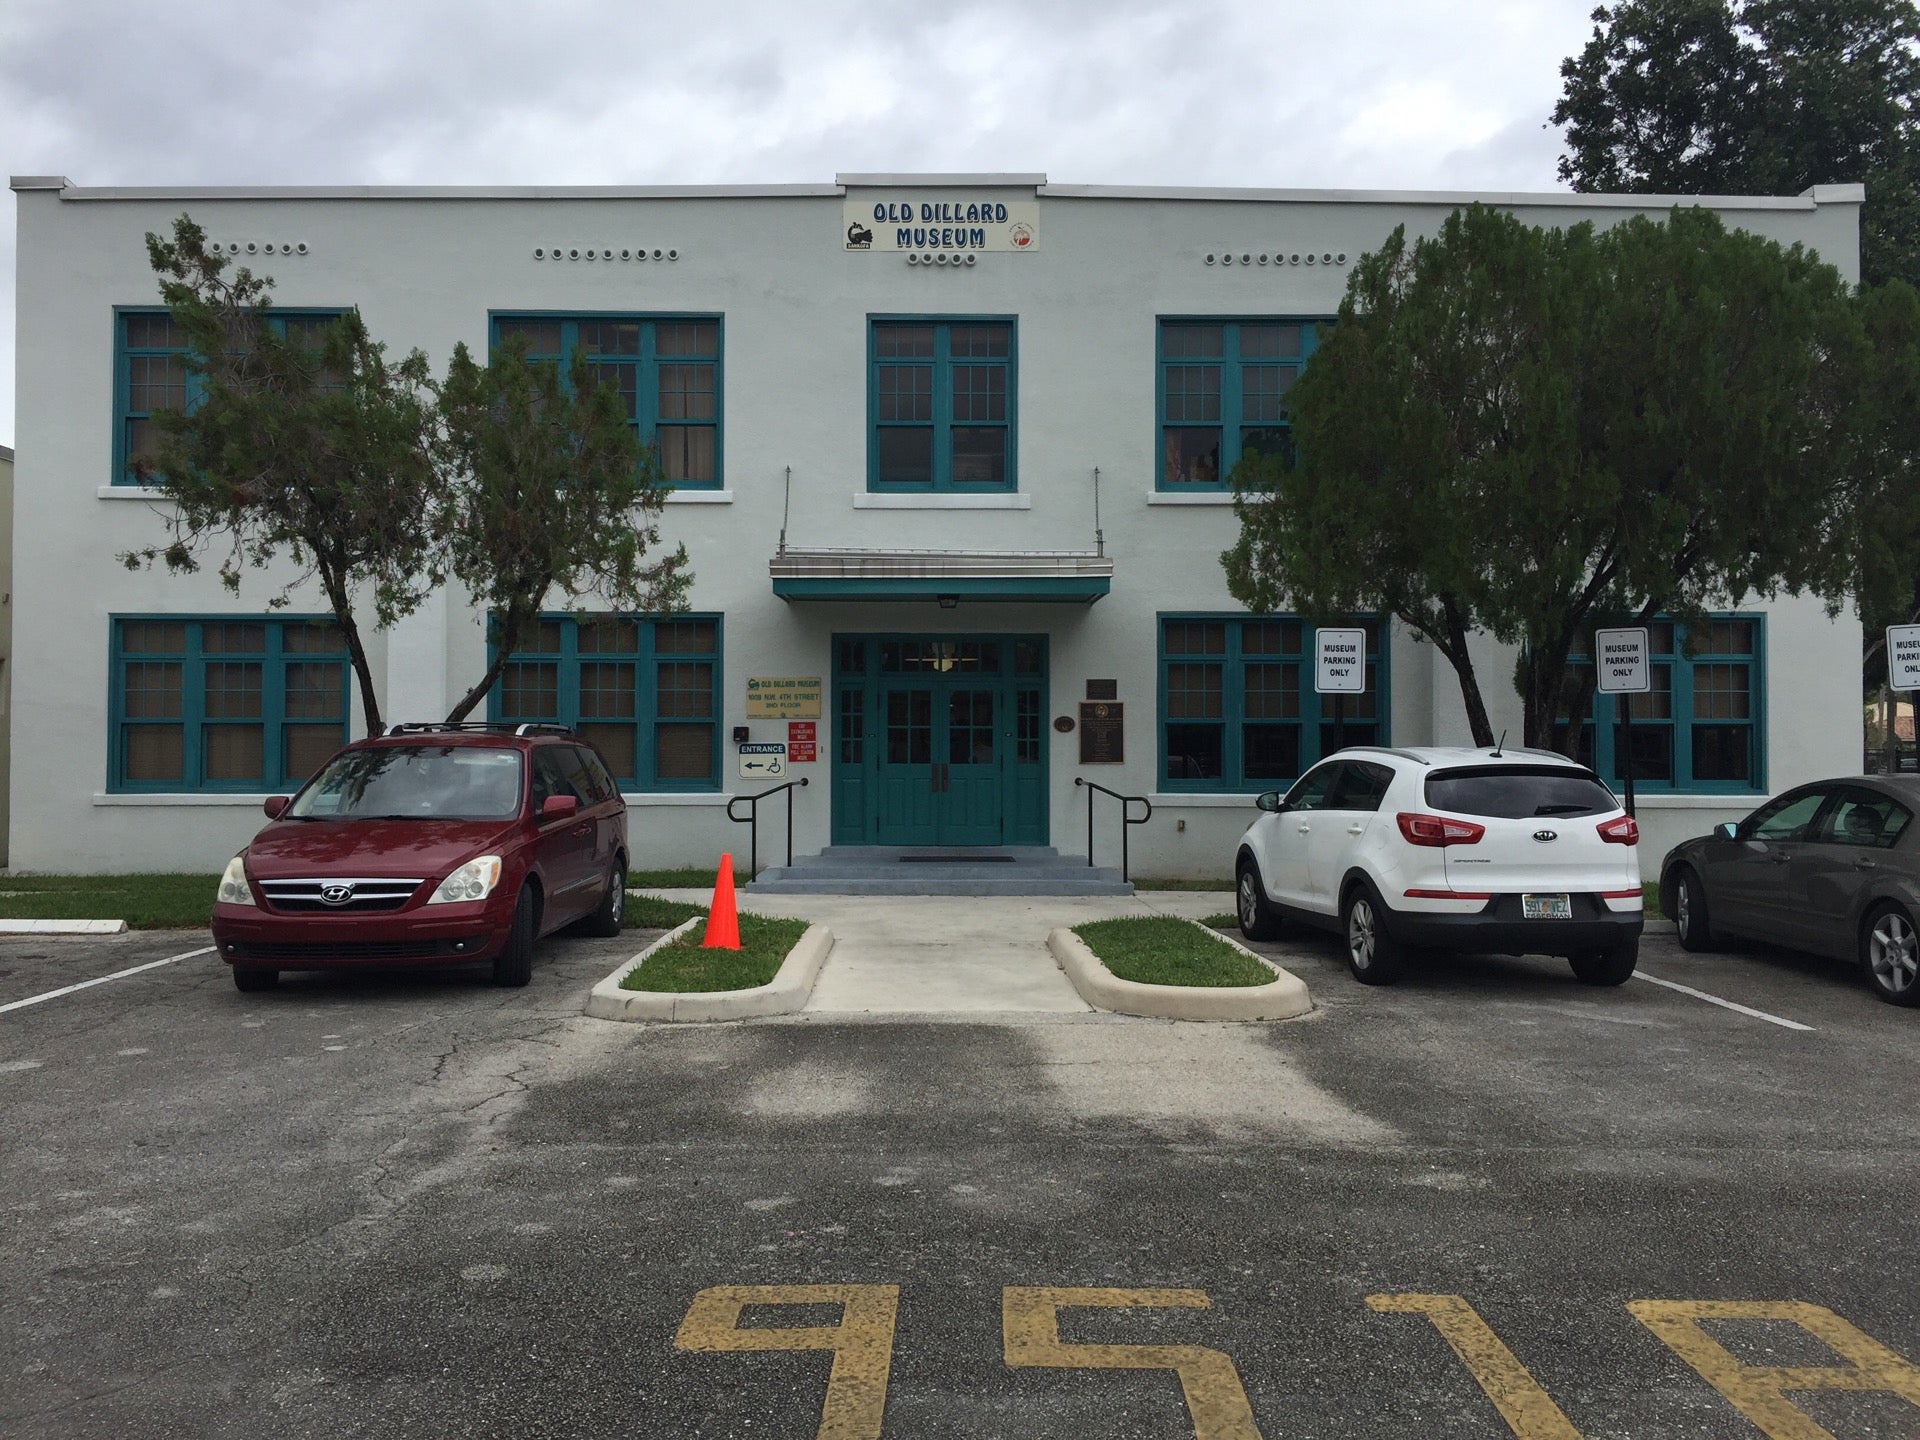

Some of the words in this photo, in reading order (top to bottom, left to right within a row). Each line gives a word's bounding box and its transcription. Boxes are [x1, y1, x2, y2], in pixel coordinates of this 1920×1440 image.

[873, 203, 913, 222] OLD
[921, 203, 1008, 223] DILLARD
[897, 228, 986, 248] MUSEUM
[1605, 644, 1639, 653] MUSEUM
[1605, 656, 1640, 664] PARKING
[1904, 665, 1920, 673] ONL
[741, 745, 784, 753] ENTRANCE
